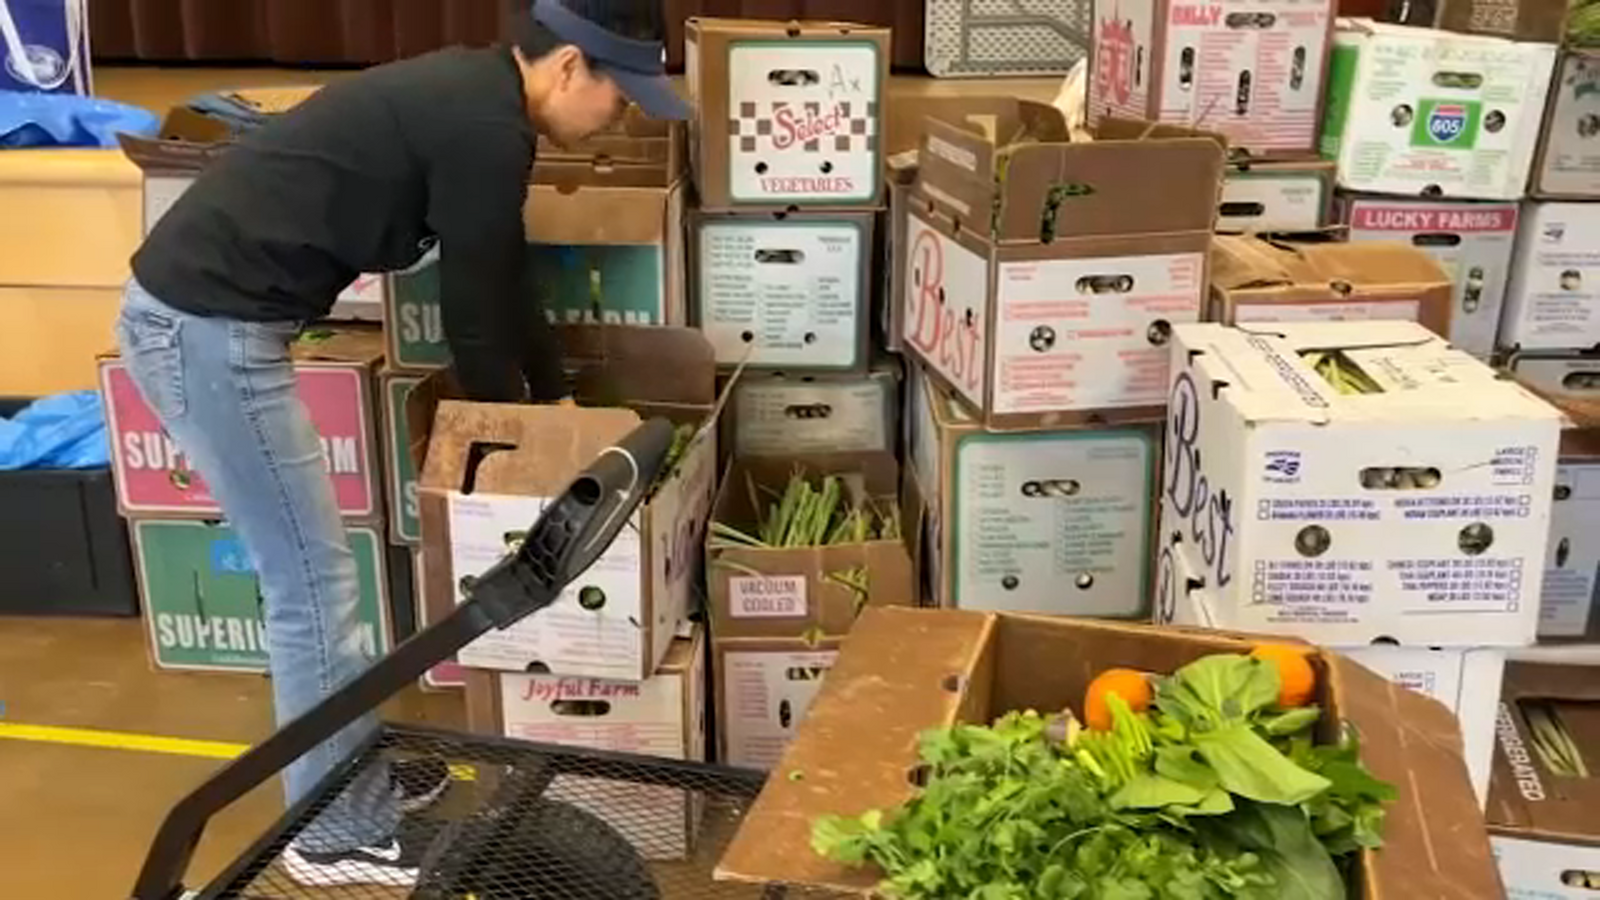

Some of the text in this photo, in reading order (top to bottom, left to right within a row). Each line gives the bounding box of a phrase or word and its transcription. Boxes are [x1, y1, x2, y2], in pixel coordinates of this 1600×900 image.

[771, 103, 843, 150] Select
[760, 177, 854, 193] VEGETABLES
[1364, 211, 1503, 229] LUCKY FARMS
[909, 228, 980, 391] Best
[1167, 372, 1233, 587] Best
[740, 580, 797, 595] VACUUM
[742, 596, 797, 613] COOLED
[158, 612, 268, 651] SUPERI
[520, 679, 641, 701] Joyful Farm
